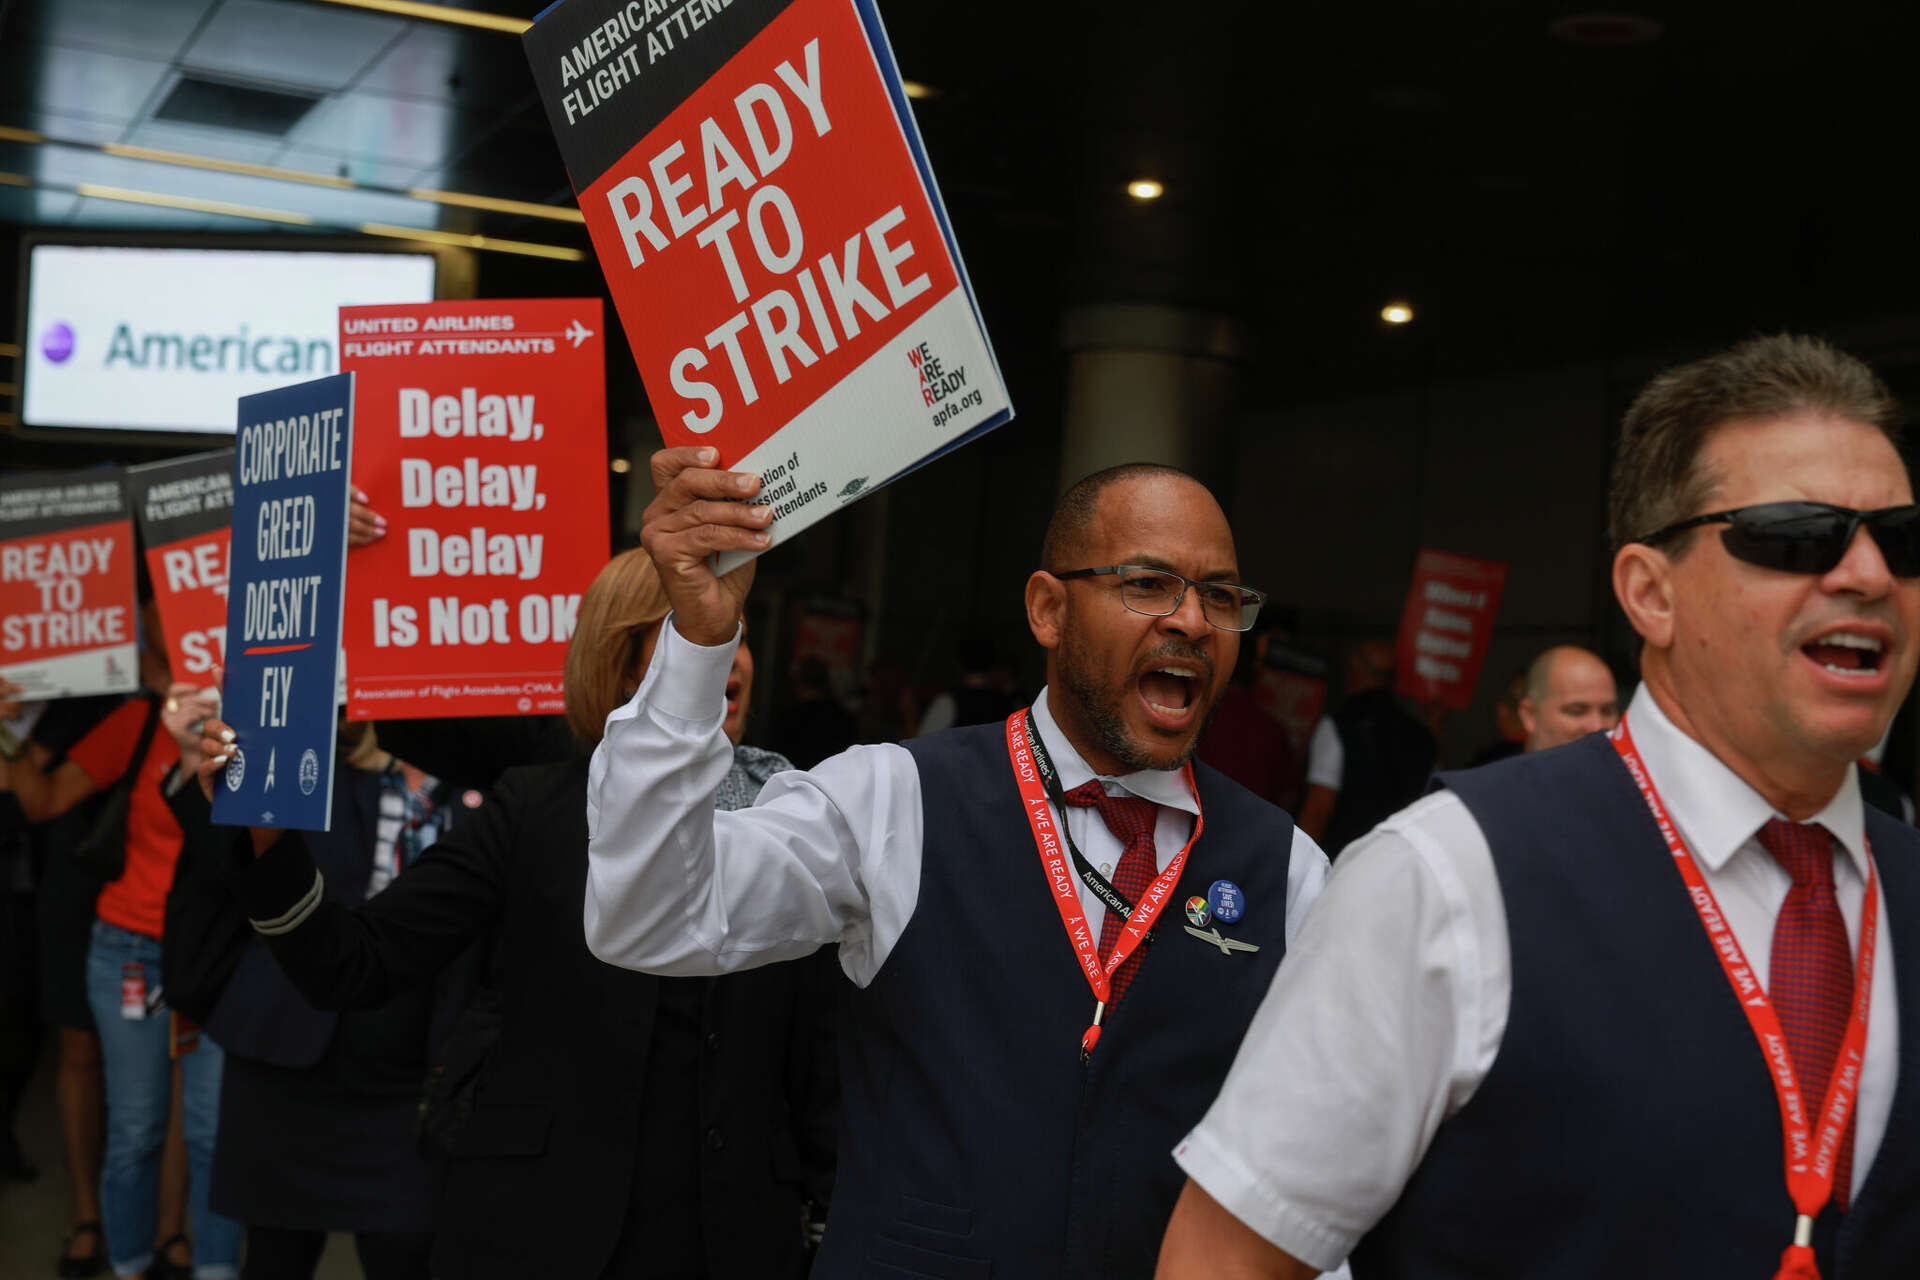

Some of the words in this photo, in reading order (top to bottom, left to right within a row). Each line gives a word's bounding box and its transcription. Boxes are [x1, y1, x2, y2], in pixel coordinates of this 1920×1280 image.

[560, 0, 677, 88] AMERICA
[562, 44, 641, 126] FLIGHT
[647, 0, 735, 65] ATTEN
[606, 37, 832, 269] READY
[696, 184, 804, 304] TO
[344, 317, 418, 334] UNITED
[423, 315, 514, 332] AIRLINES
[670, 205, 932, 434] STRIKE
[104, 322, 332, 374] American
[344, 340, 414, 357] FLIGHT
[418, 338, 555, 355] ATTENDANTS
[907, 341, 932, 369] WE
[918, 358, 945, 389] ARE
[922, 365, 966, 408] READY
[398, 387, 545, 442] Delay,
[932, 389, 983, 427] apfa.org
[240, 408, 343, 486] CORPORATE
[148, 472, 231, 502] AMERICAN
[401, 457, 546, 511] Delay,
[760, 464, 786, 489] ation
[787, 452, 800, 471] of
[257, 495, 315, 562] GREED
[2, 537, 115, 582] READY
[163, 540, 231, 593] RE
[408, 527, 543, 580] Delay
[35, 577, 83, 613] TO
[243, 576, 321, 641] DOESN'T
[3, 606, 126, 651] STRIKE
[373, 598, 419, 647] Is
[429, 597, 510, 645] Not
[519, 594, 582, 643] OK
[260, 666, 293, 728] FLY
[1011, 731, 1025, 750] ARE
[1015, 749, 1036, 782] READY
[1034, 808, 1050, 829] WE
[1040, 833, 1059, 856] ARE
[1049, 859, 1073, 898] READY
[1083, 871, 1123, 913] American
[1133, 903, 1155, 924] WE
[1149, 882, 1170, 905] ARE
[1165, 850, 1185, 882] READY
[1688, 885, 1726, 933] READY
[1074, 926, 1090, 950] WE
[1082, 953, 1100, 978] ARE
[1715, 934, 1743, 963] ARE
